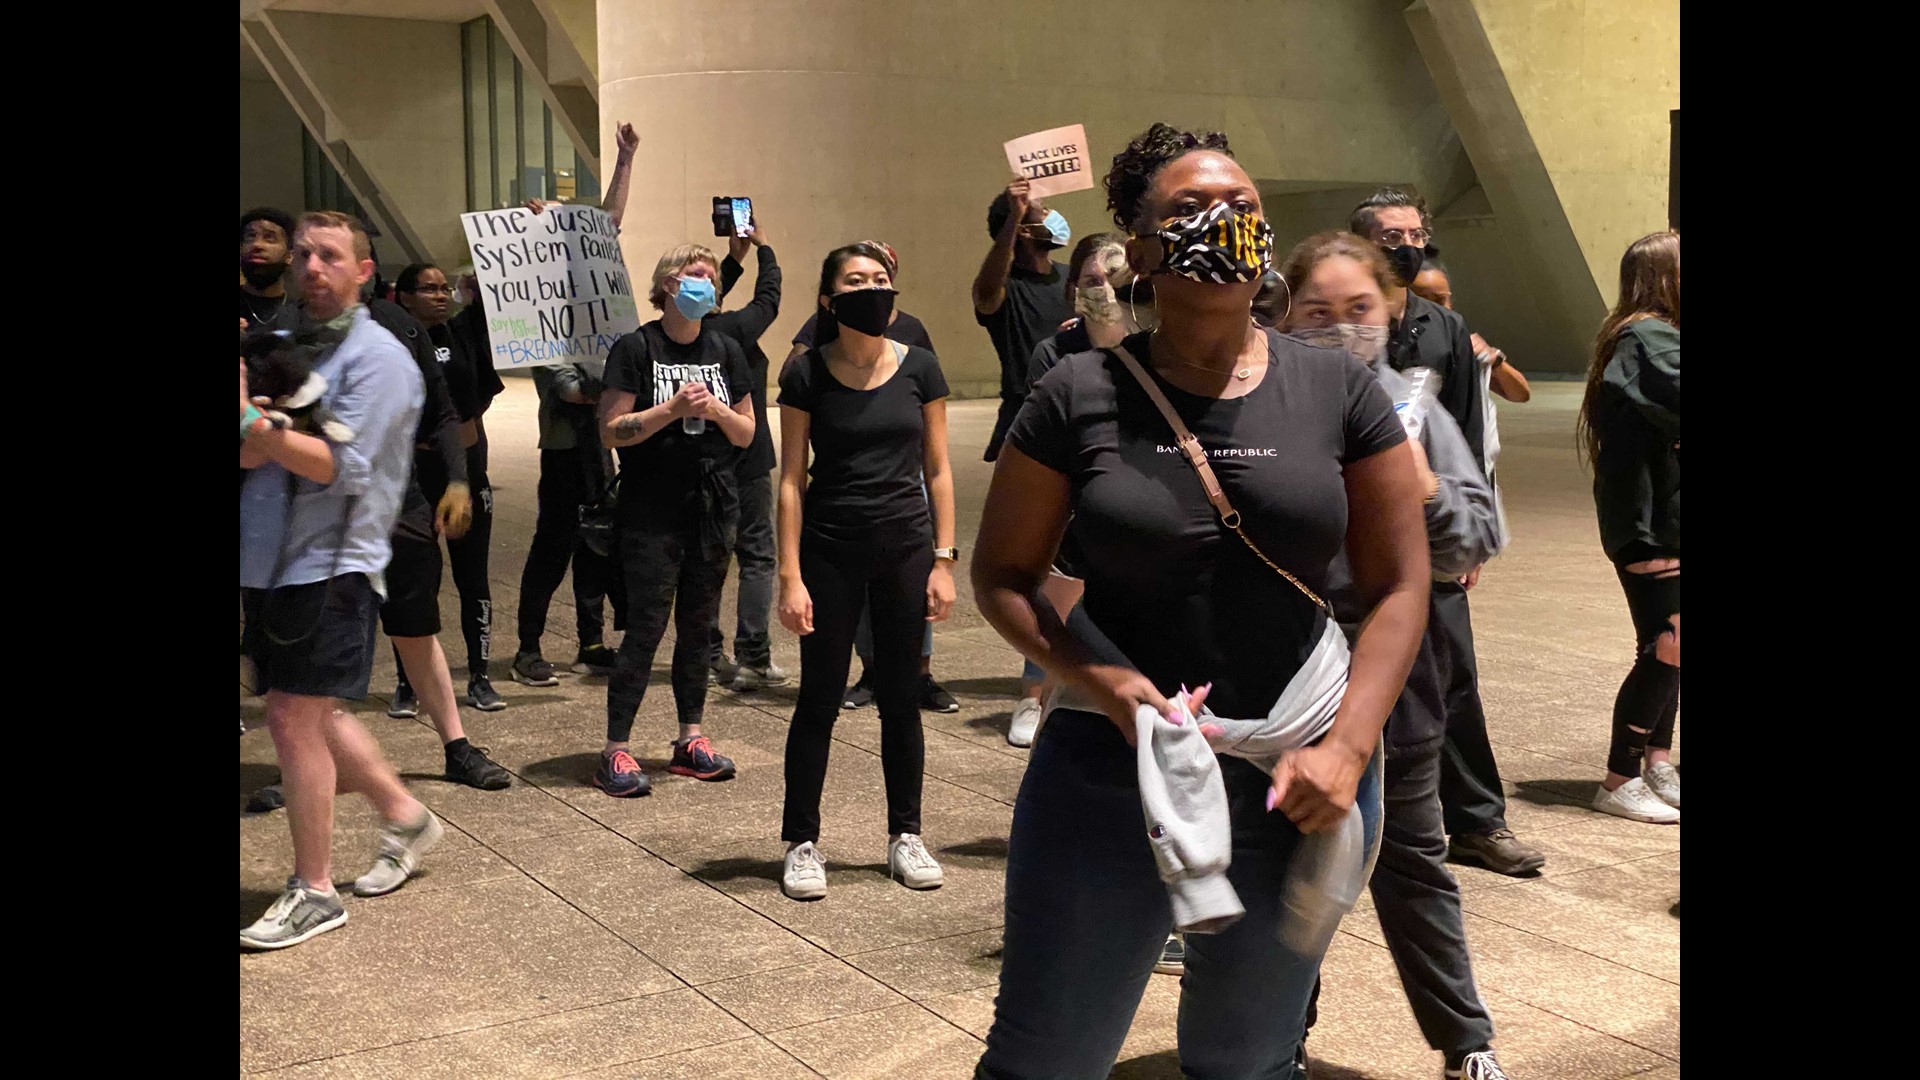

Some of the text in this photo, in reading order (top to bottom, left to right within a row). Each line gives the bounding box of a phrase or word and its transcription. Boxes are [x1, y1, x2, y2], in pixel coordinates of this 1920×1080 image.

[1019, 144, 1078, 164] BLACK LIVES
[1022, 158, 1080, 179] MATTER
[469, 210, 527, 238] The
[580, 235, 626, 268] failed
[590, 269, 600, 296] I
[538, 298, 610, 342] NOT!
[496, 332, 622, 363] #BREONNATAY
[1156, 444, 1278, 458] BANA REPUBLIC
